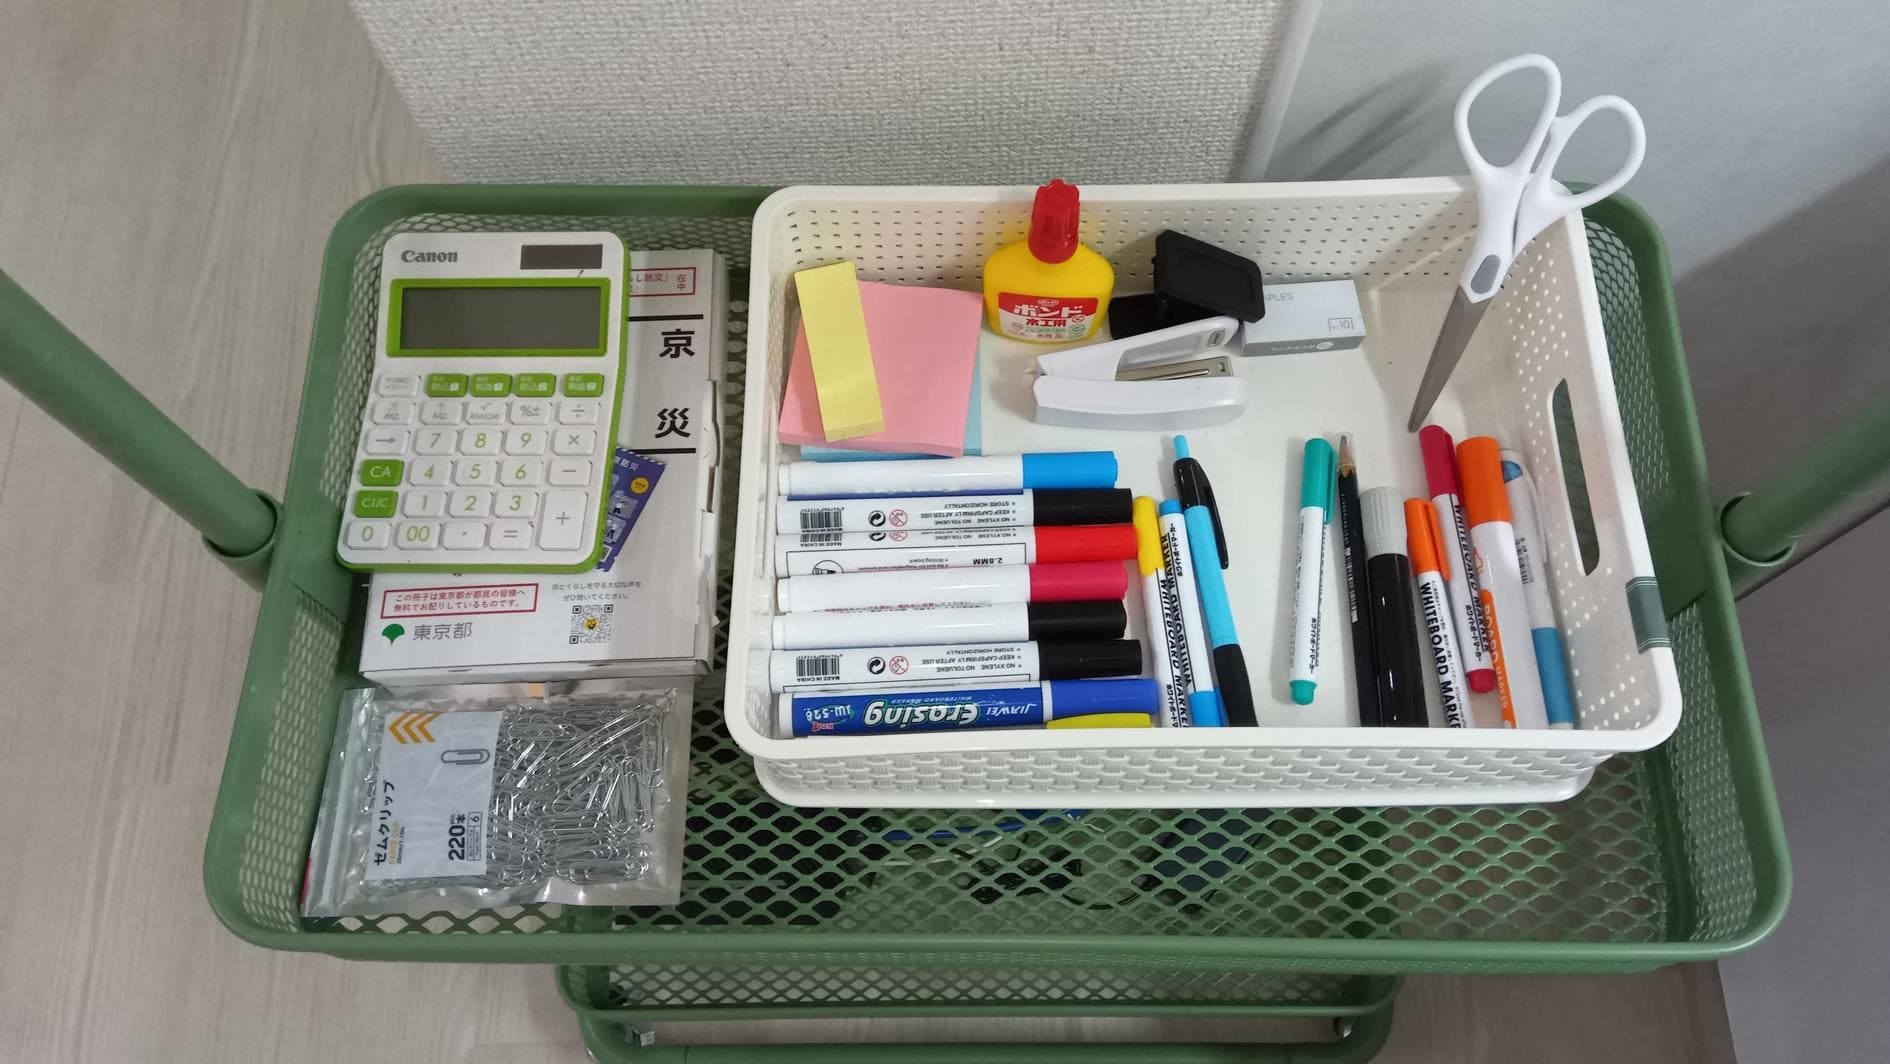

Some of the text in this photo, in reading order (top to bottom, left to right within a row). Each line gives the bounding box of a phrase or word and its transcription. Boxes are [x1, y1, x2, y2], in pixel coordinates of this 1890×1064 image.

[401, 250, 458, 263] Canon
[1013, 304, 1083, 318] ボンド
[1026, 318, 1066, 327] 木工用
[655, 408, 690, 438] 災
[430, 433, 441, 447] 7
[475, 433, 487, 448] 8
[520, 433, 532, 448] 9
[370, 466, 391, 478] CA
[424, 465, 434, 479] 4
[469, 464, 481, 479] 5
[515, 464, 527, 480] 6
[420, 496, 428, 510] 1
[465, 496, 477, 510] 2
[510, 495, 521, 510] 3
[362, 526, 373, 541] 0
[406, 526, 430, 541] 00
[1170, 522, 1183, 576] ホワイトボードマーカー
[1454, 504, 1479, 591] WHITEBOARD
[973, 557, 1002, 565] 2.8MM
[396, 589, 526, 602] この冊子は東京都が都民の皆様へ
[393, 600, 519, 612] 無料でお配りしているものです。
[1160, 534, 1192, 685] WHITEBOARD MARKER
[413, 622, 472, 641] 東京都
[1420, 582, 1449, 675] WHITEBOARD
[1465, 605, 1482, 662] ホワイトボードマーカー
[864, 701, 979, 728] Erasing
[986, 704, 1037, 716] JIAWEI
[374, 780, 394, 865] ゼムクリップ
